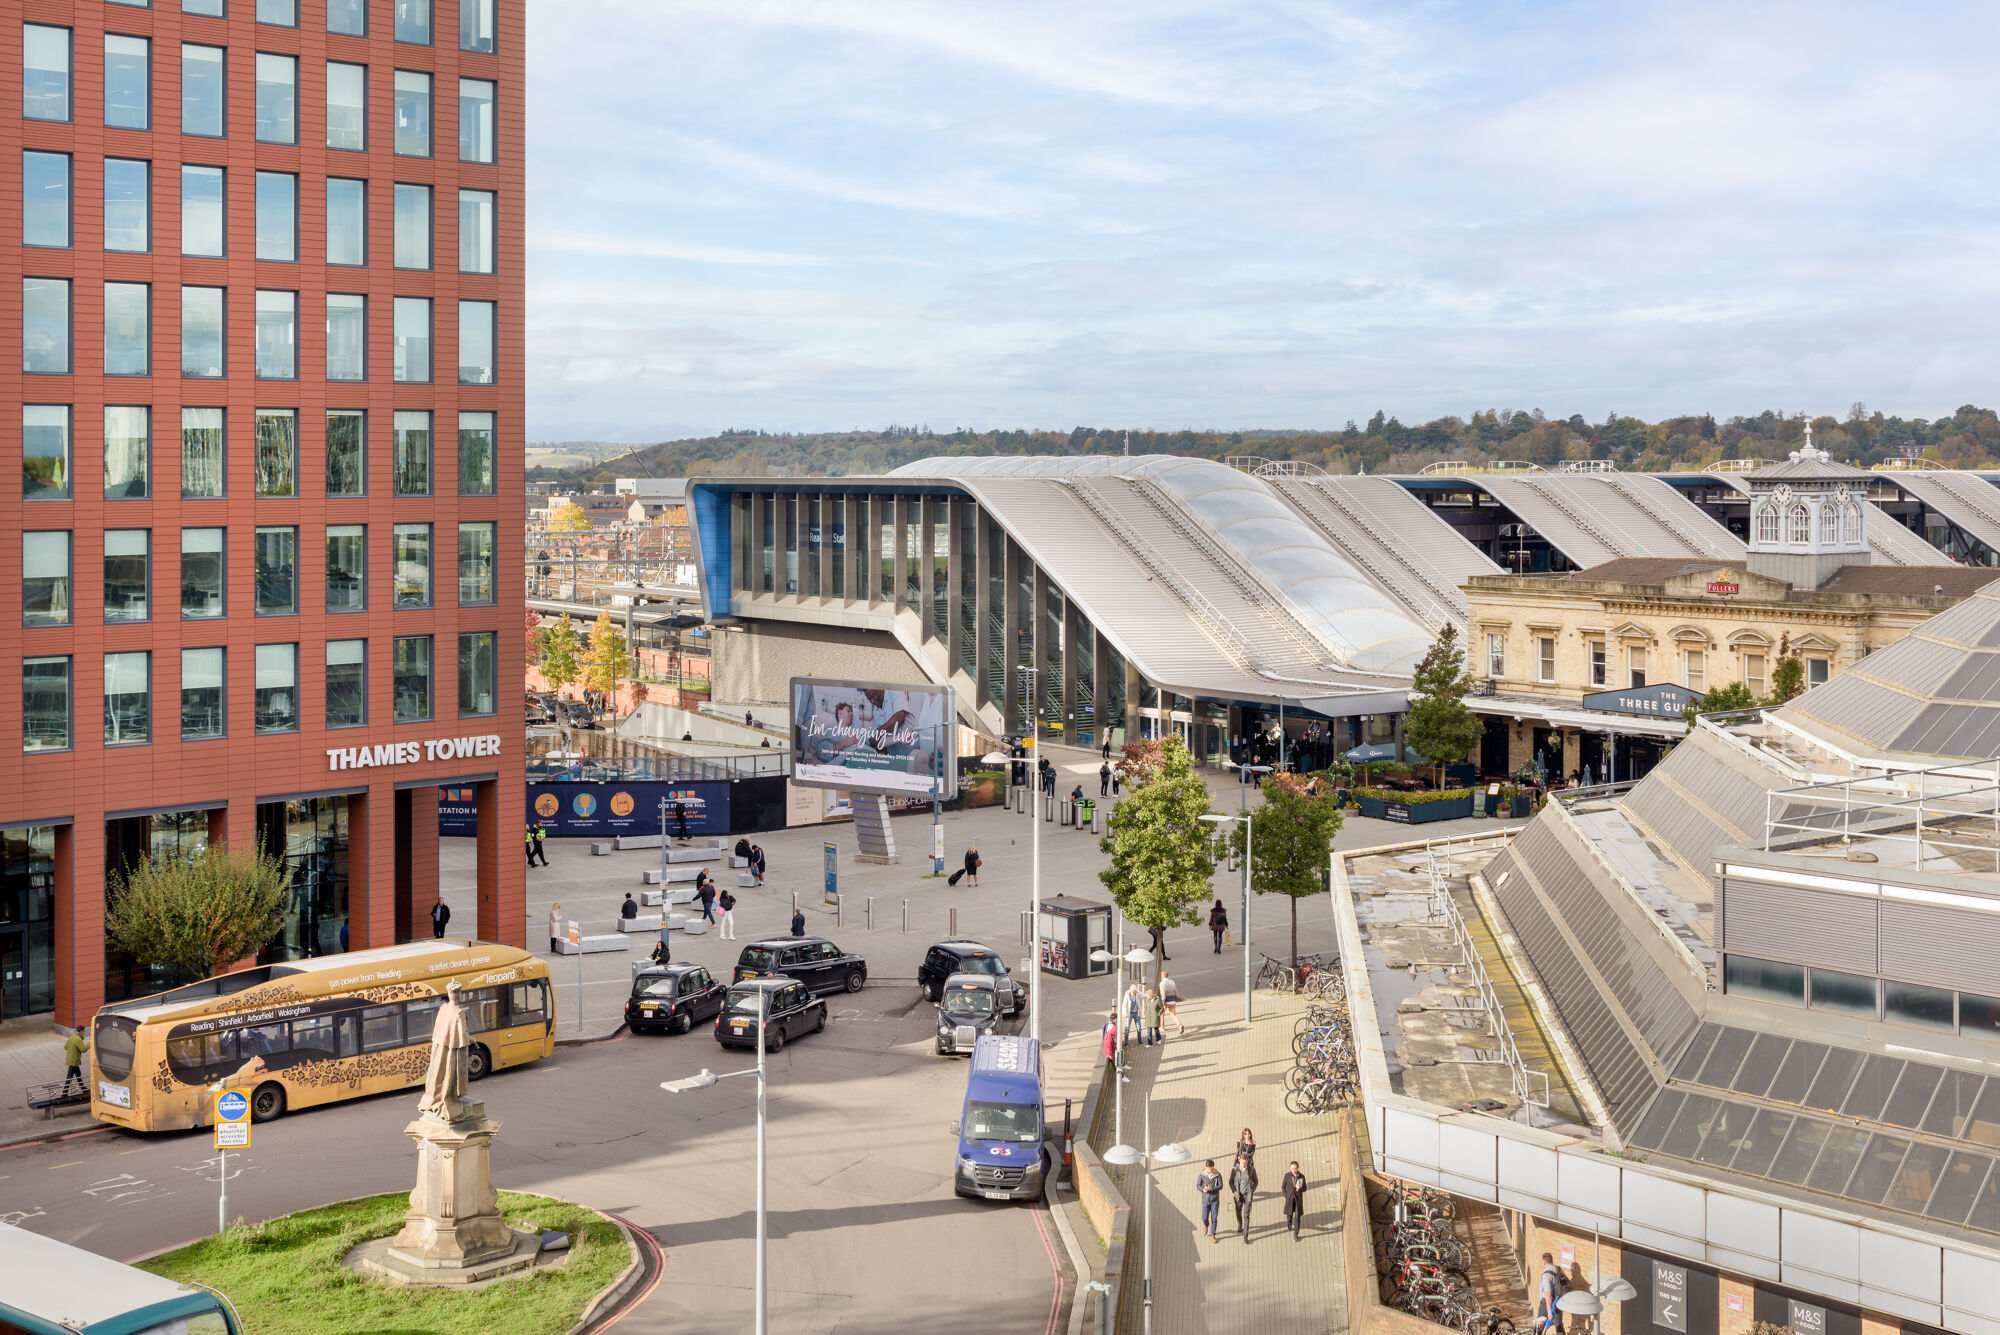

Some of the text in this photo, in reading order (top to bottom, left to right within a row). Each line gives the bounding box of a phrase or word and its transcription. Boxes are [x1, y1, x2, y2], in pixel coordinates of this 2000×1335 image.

[1619, 698, 1658, 710] THREE
[1661, 692, 1676, 700] THE
[326, 735, 501, 771] THAMES TOWER
[428, 963, 450, 973] quieter,
[449, 959, 470, 969] cleaner,
[470, 956, 491, 967] greener
[328, 980, 340, 989] gas
[341, 976, 359, 987] power
[360, 974, 375, 982] from
[376, 970, 402, 979] Reading
[486, 968, 516, 984] leopard
[190, 1006, 311, 1032] Reading Shinfield Arborfield Wokingham
[1658, 1268, 1683, 1285] M&S
[1663, 1282, 1677, 1290] FOOD
[1659, 1291, 1682, 1303] THIS WAY
[1794, 1306, 1821, 1325] M&S
[1800, 1322, 1816, 1330] FOOD
